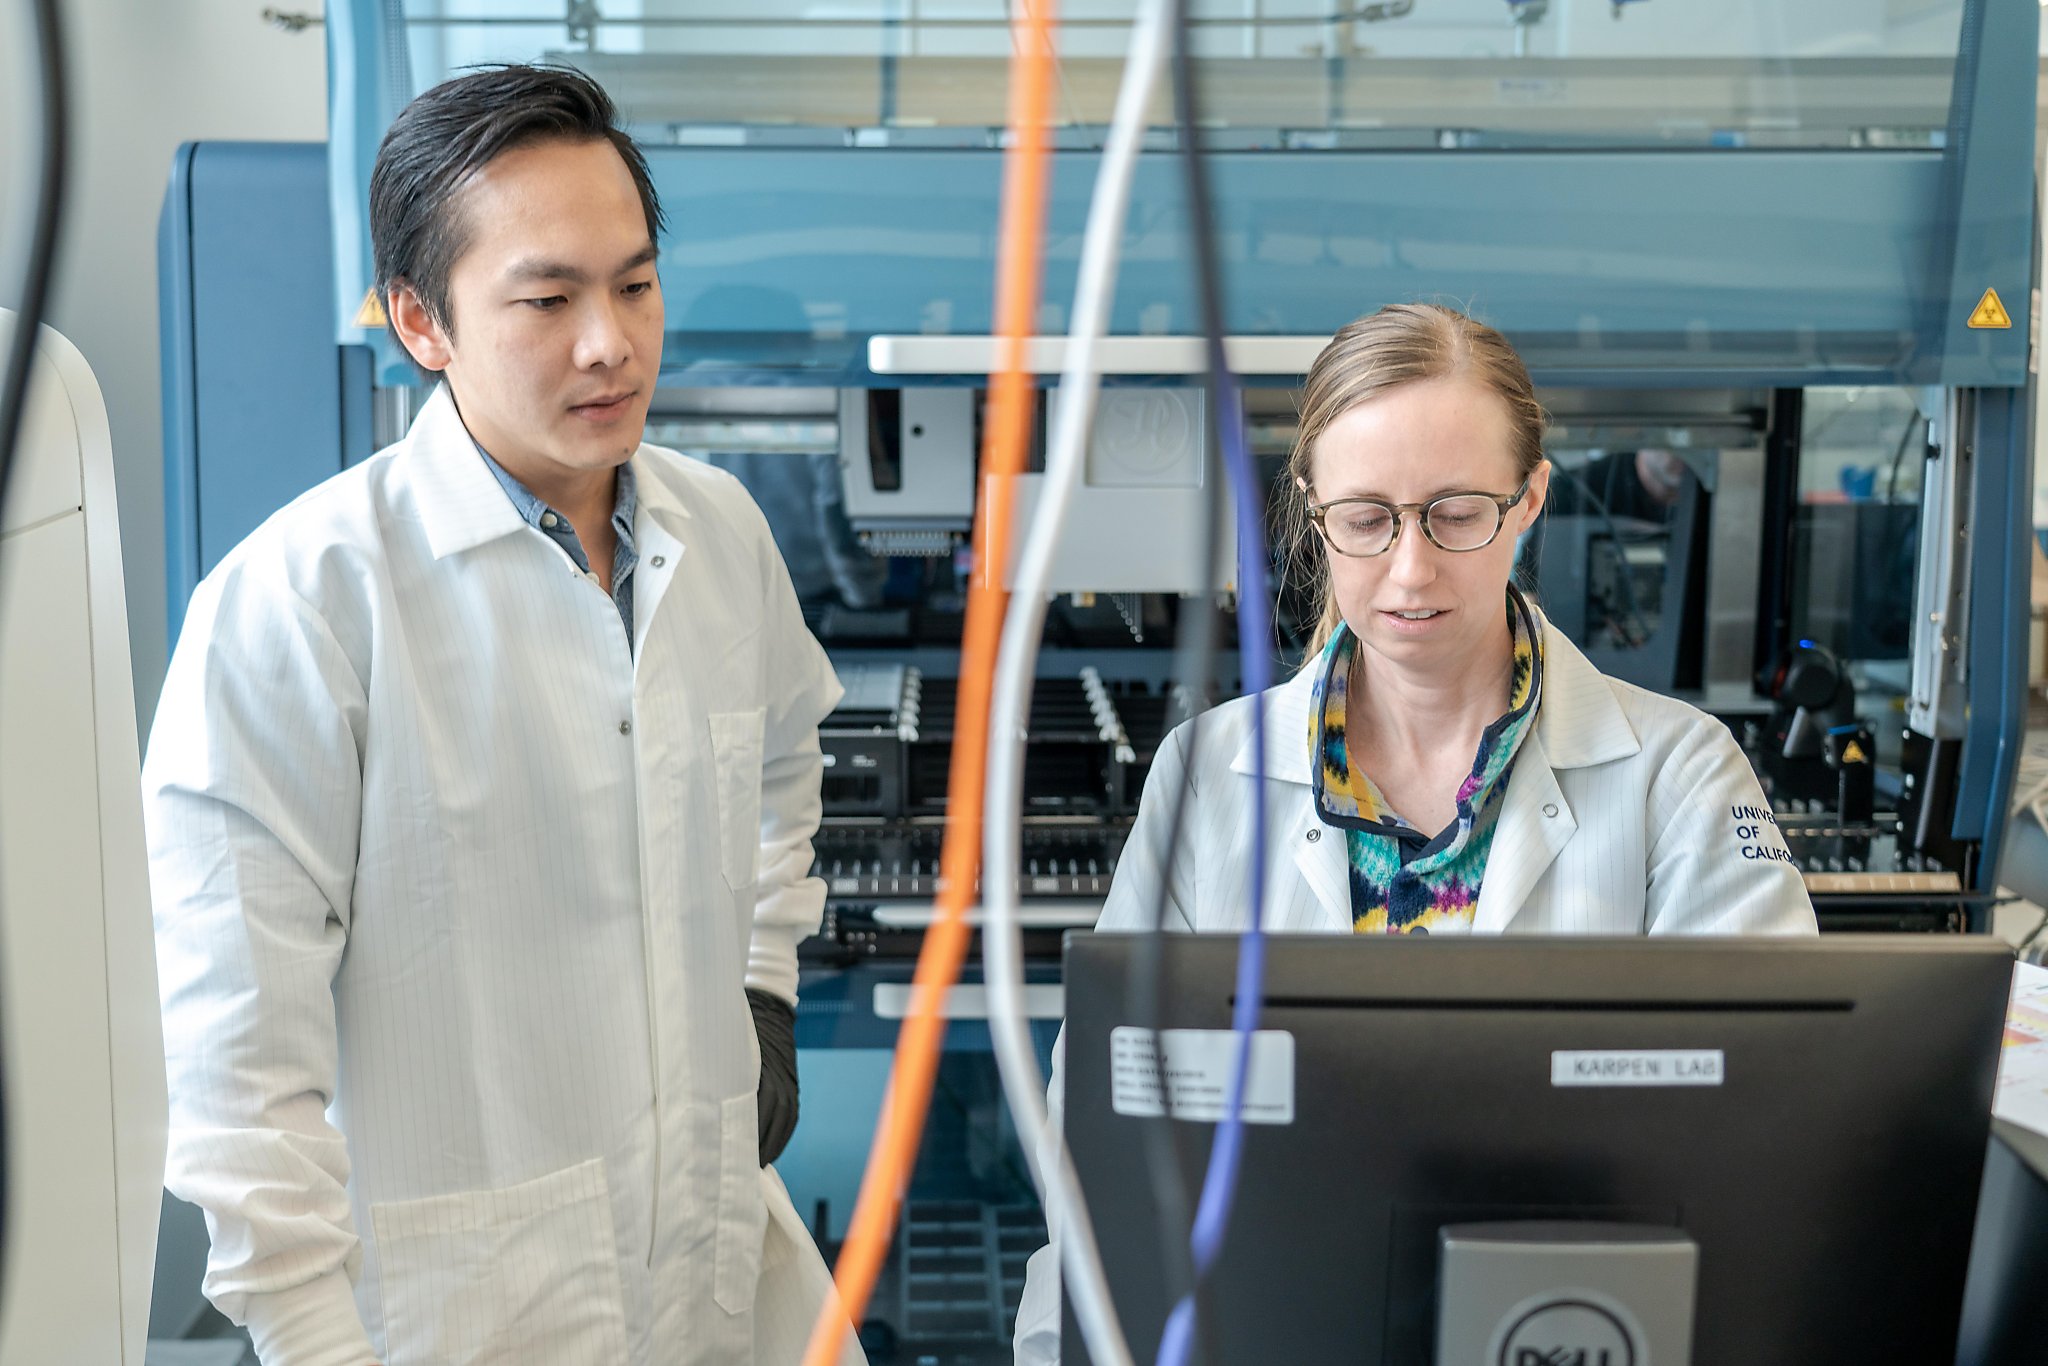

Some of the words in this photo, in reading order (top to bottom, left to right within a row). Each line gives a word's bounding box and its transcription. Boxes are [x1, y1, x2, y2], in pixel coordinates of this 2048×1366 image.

[1737, 825, 1760, 839] OF
[1742, 846, 1795, 865] CALIFO
[1574, 1057, 1661, 1076] KARPEN
[1675, 1057, 1716, 1076] LAB
